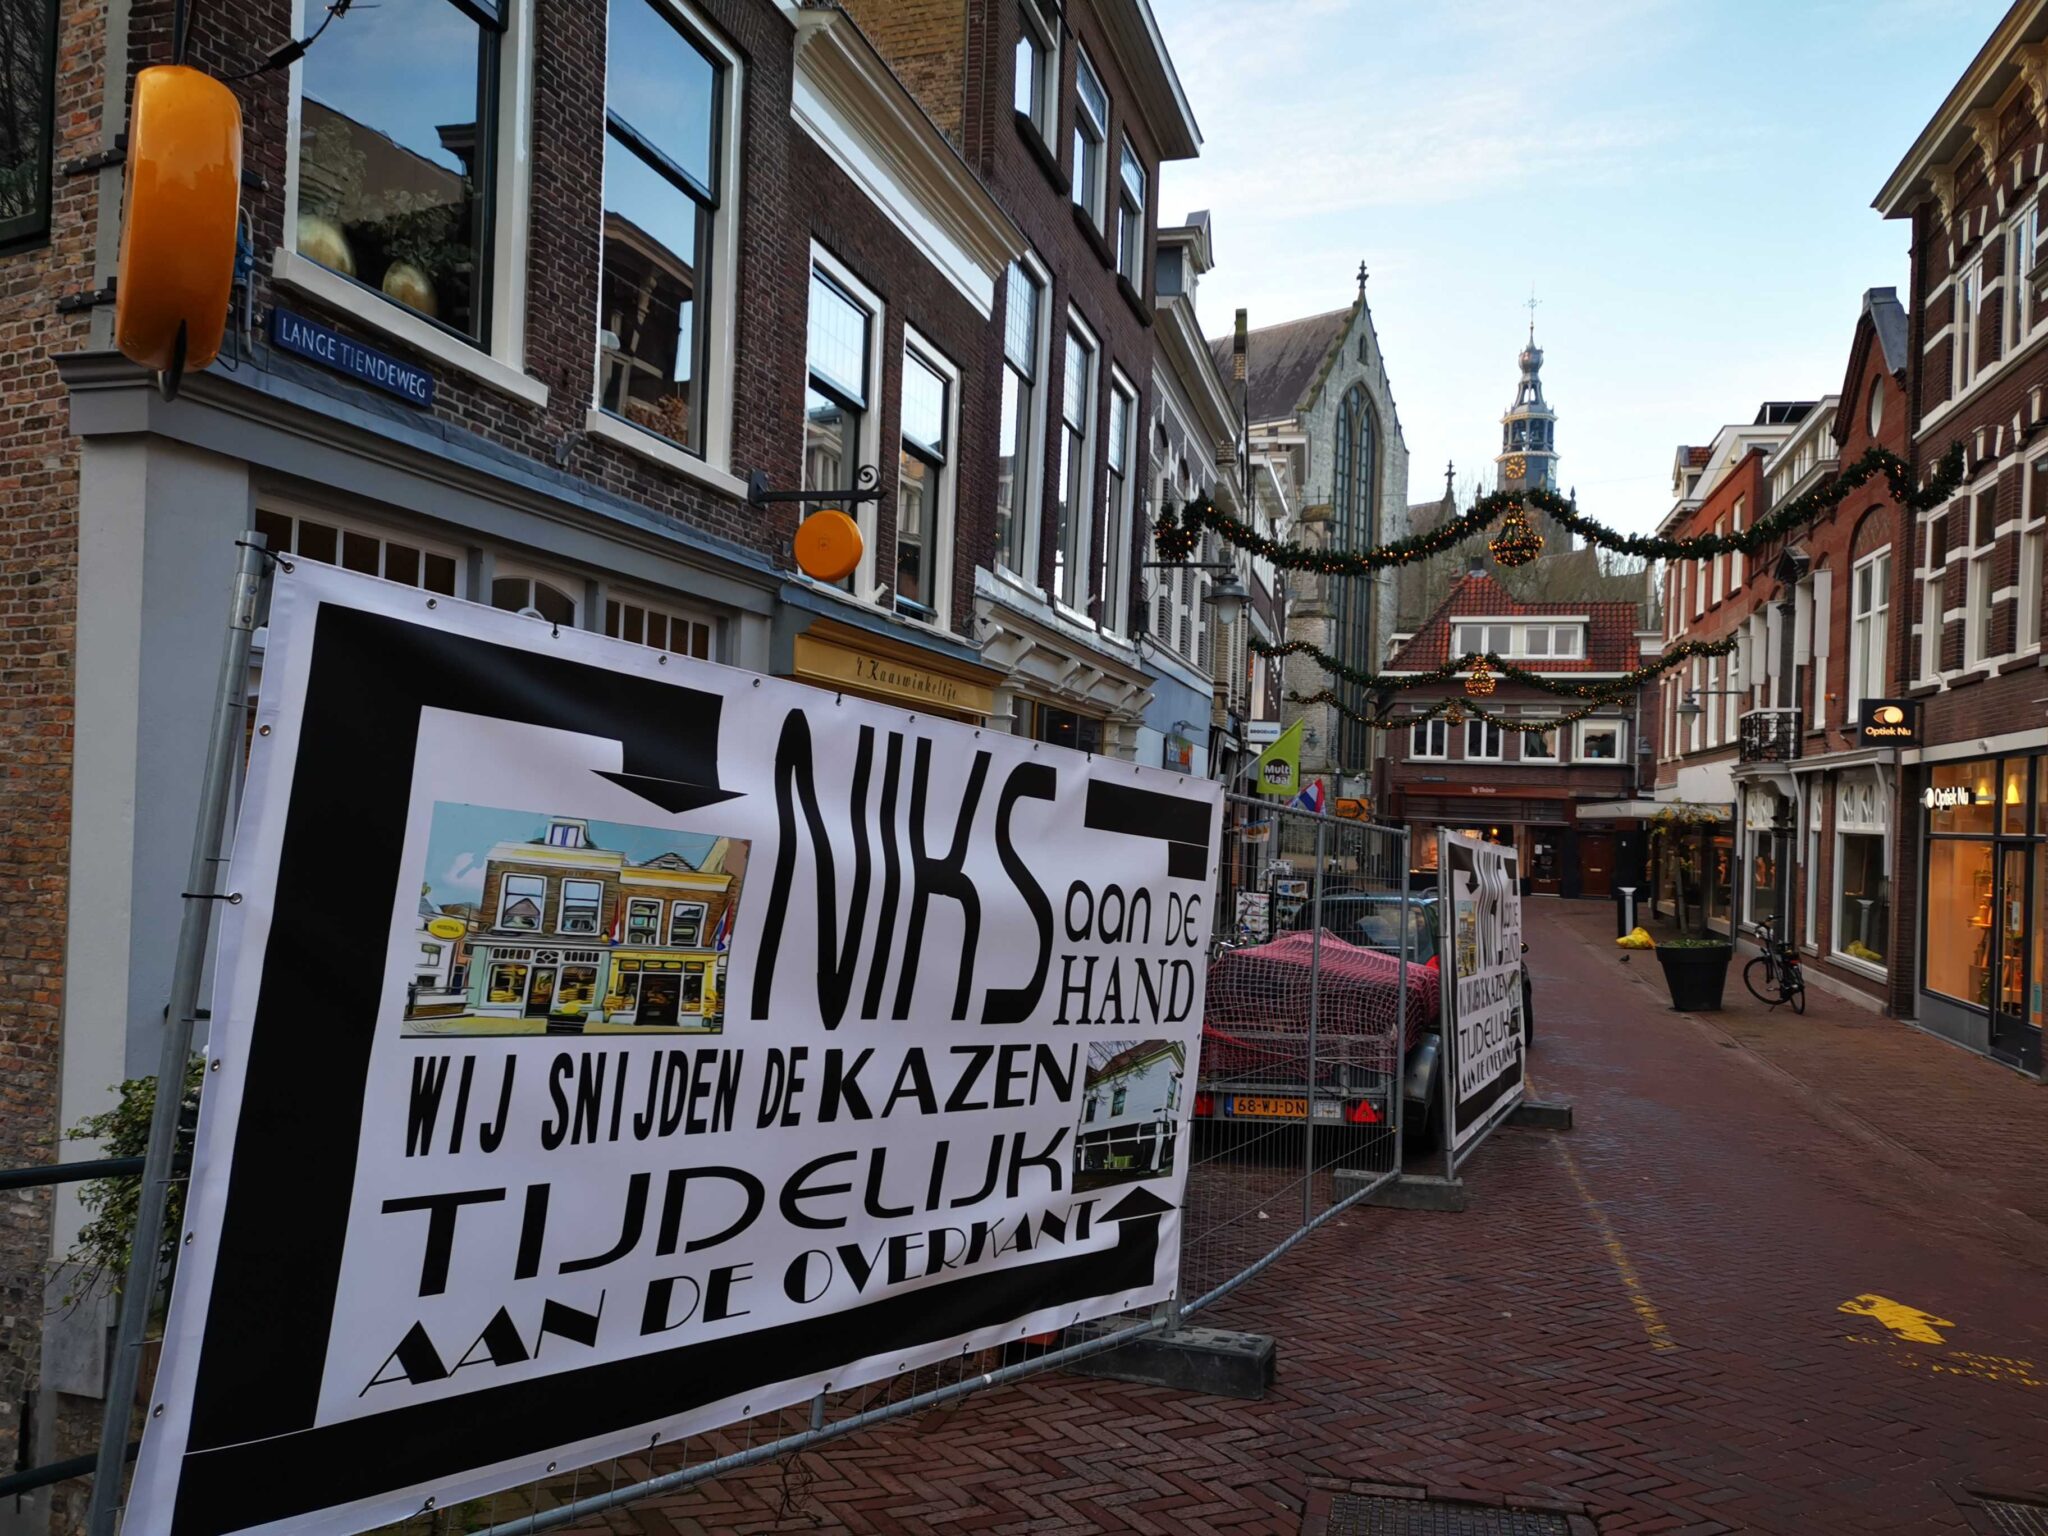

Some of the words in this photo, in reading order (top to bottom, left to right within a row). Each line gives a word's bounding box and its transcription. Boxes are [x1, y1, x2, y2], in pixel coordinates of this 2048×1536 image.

[282, 317, 336, 361] LANGE
[340, 342, 426, 399] TIENDEWEG
[867, 659, 957, 701] Kaaswinkeltje
[1865, 726, 1896, 737] Optiek
[1897, 727, 1912, 736] Nu
[1264, 765, 1292, 774] Multi
[1934, 787, 1957, 811] Optiek
[1957, 786, 1969, 806] Nu
[751, 708, 1057, 1030] NIKS
[1065, 879, 1152, 944] aan
[1165, 890, 1201, 948] DE
[1053, 955, 1195, 1026] HAND
[405, 1053, 517, 1158] WIJ
[541, 1049, 744, 1151] SNIJDEN
[756, 1046, 808, 1129] DE
[817, 1043, 1078, 1123] KAZEN
[1238, 1098, 1305, 1114] 68-WJ-DN
[381, 1126, 1071, 1298] TIJDELIJK
[359, 1288, 606, 1398] AAN
[640, 1262, 754, 1336] DE
[783, 1198, 1101, 1304] OVERKANT
